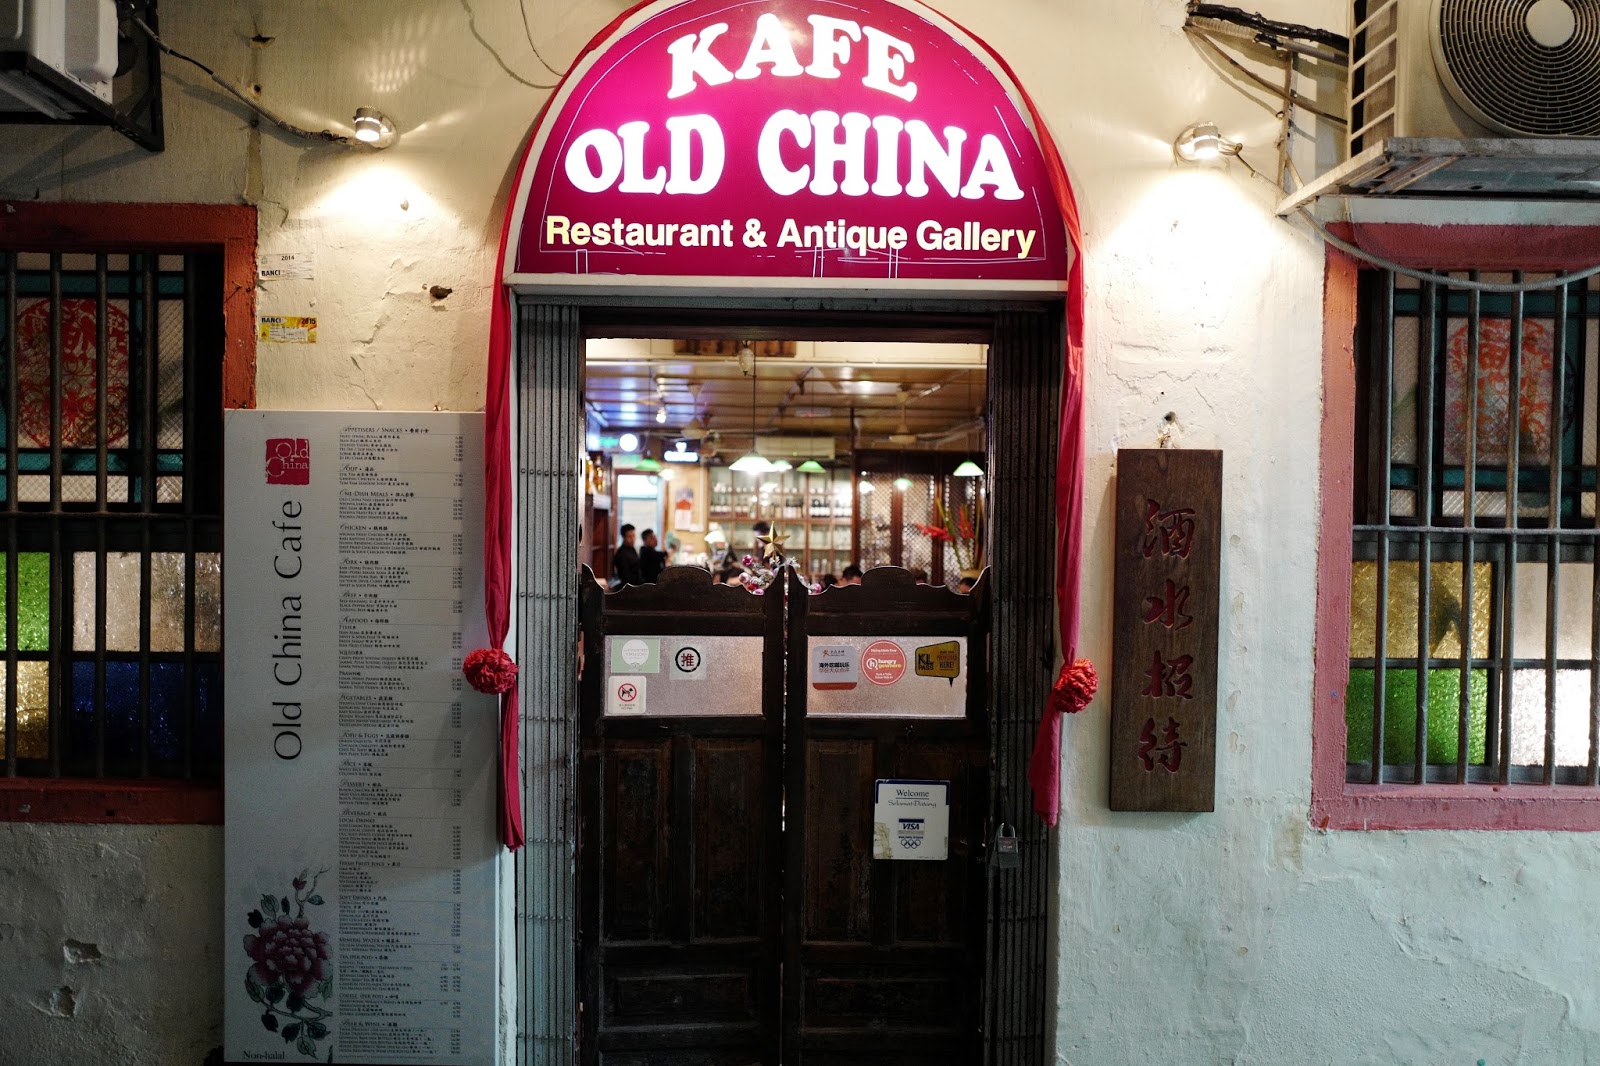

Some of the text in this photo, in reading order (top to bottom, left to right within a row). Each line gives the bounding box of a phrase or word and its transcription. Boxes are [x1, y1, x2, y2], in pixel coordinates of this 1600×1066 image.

[667, 13, 918, 102] KAFE
[564, 108, 1025, 200] OLD CHINA
[546, 215, 1036, 259] Restaurant & Antique Gallery
[261, 269, 281, 277] BANCI
[275, 438, 310, 458] Old
[266, 456, 310, 478] China
[272, 500, 302, 761] Old China Cafe
[1137, 498, 1196, 774] 酒水招待
[680, 654, 694, 666] 推
[918, 654, 933, 664] KL
[896, 789, 929, 797] Welcome
